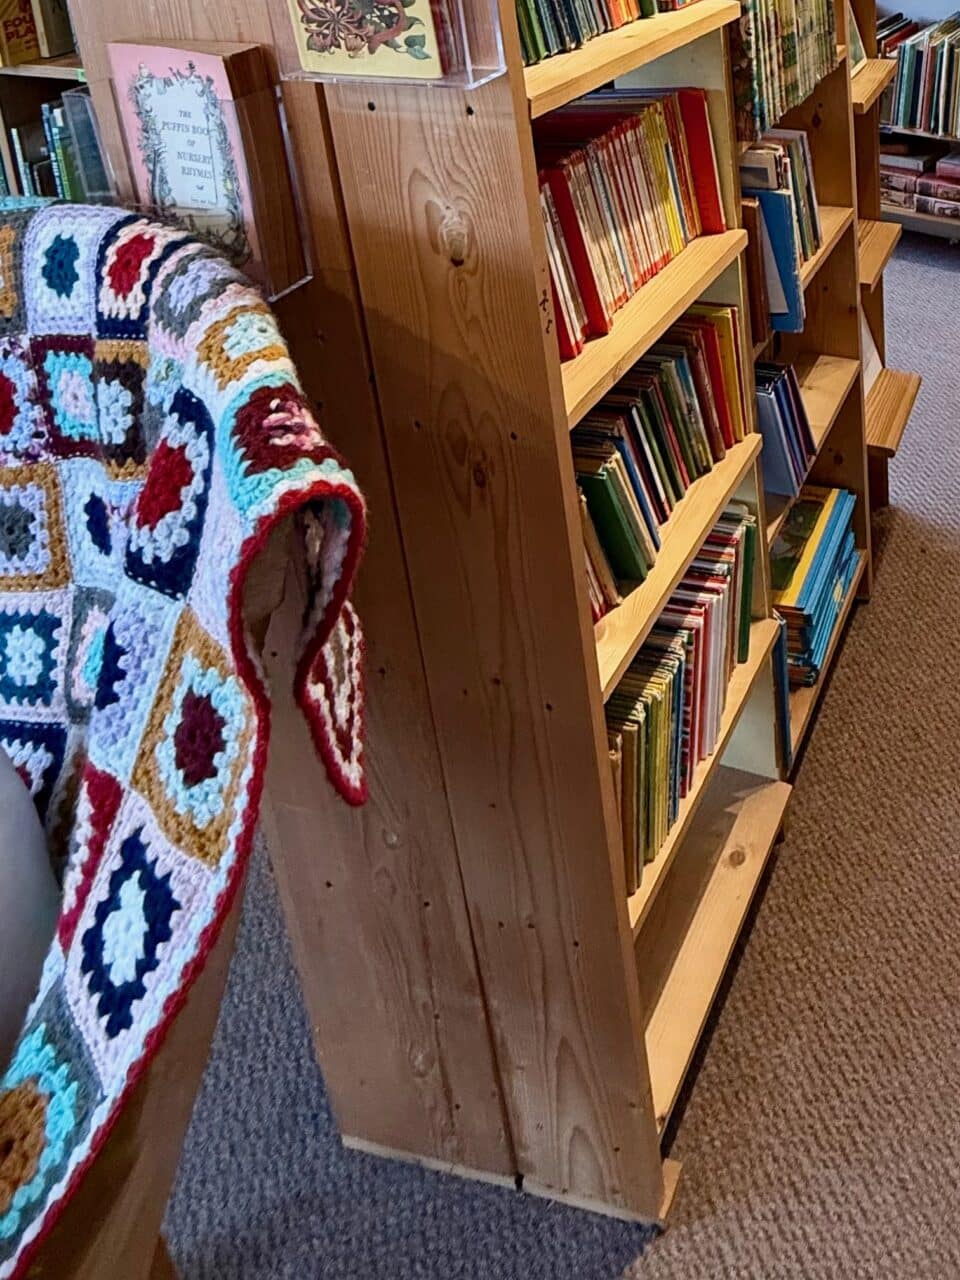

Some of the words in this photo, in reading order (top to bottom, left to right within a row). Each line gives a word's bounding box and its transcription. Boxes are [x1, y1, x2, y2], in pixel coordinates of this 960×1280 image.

[179, 110, 191, 119] THE
[161, 121, 190, 133] PUFFIN
[177, 151, 212, 164] NURSERY
[181, 166, 212, 179] RHYMES
